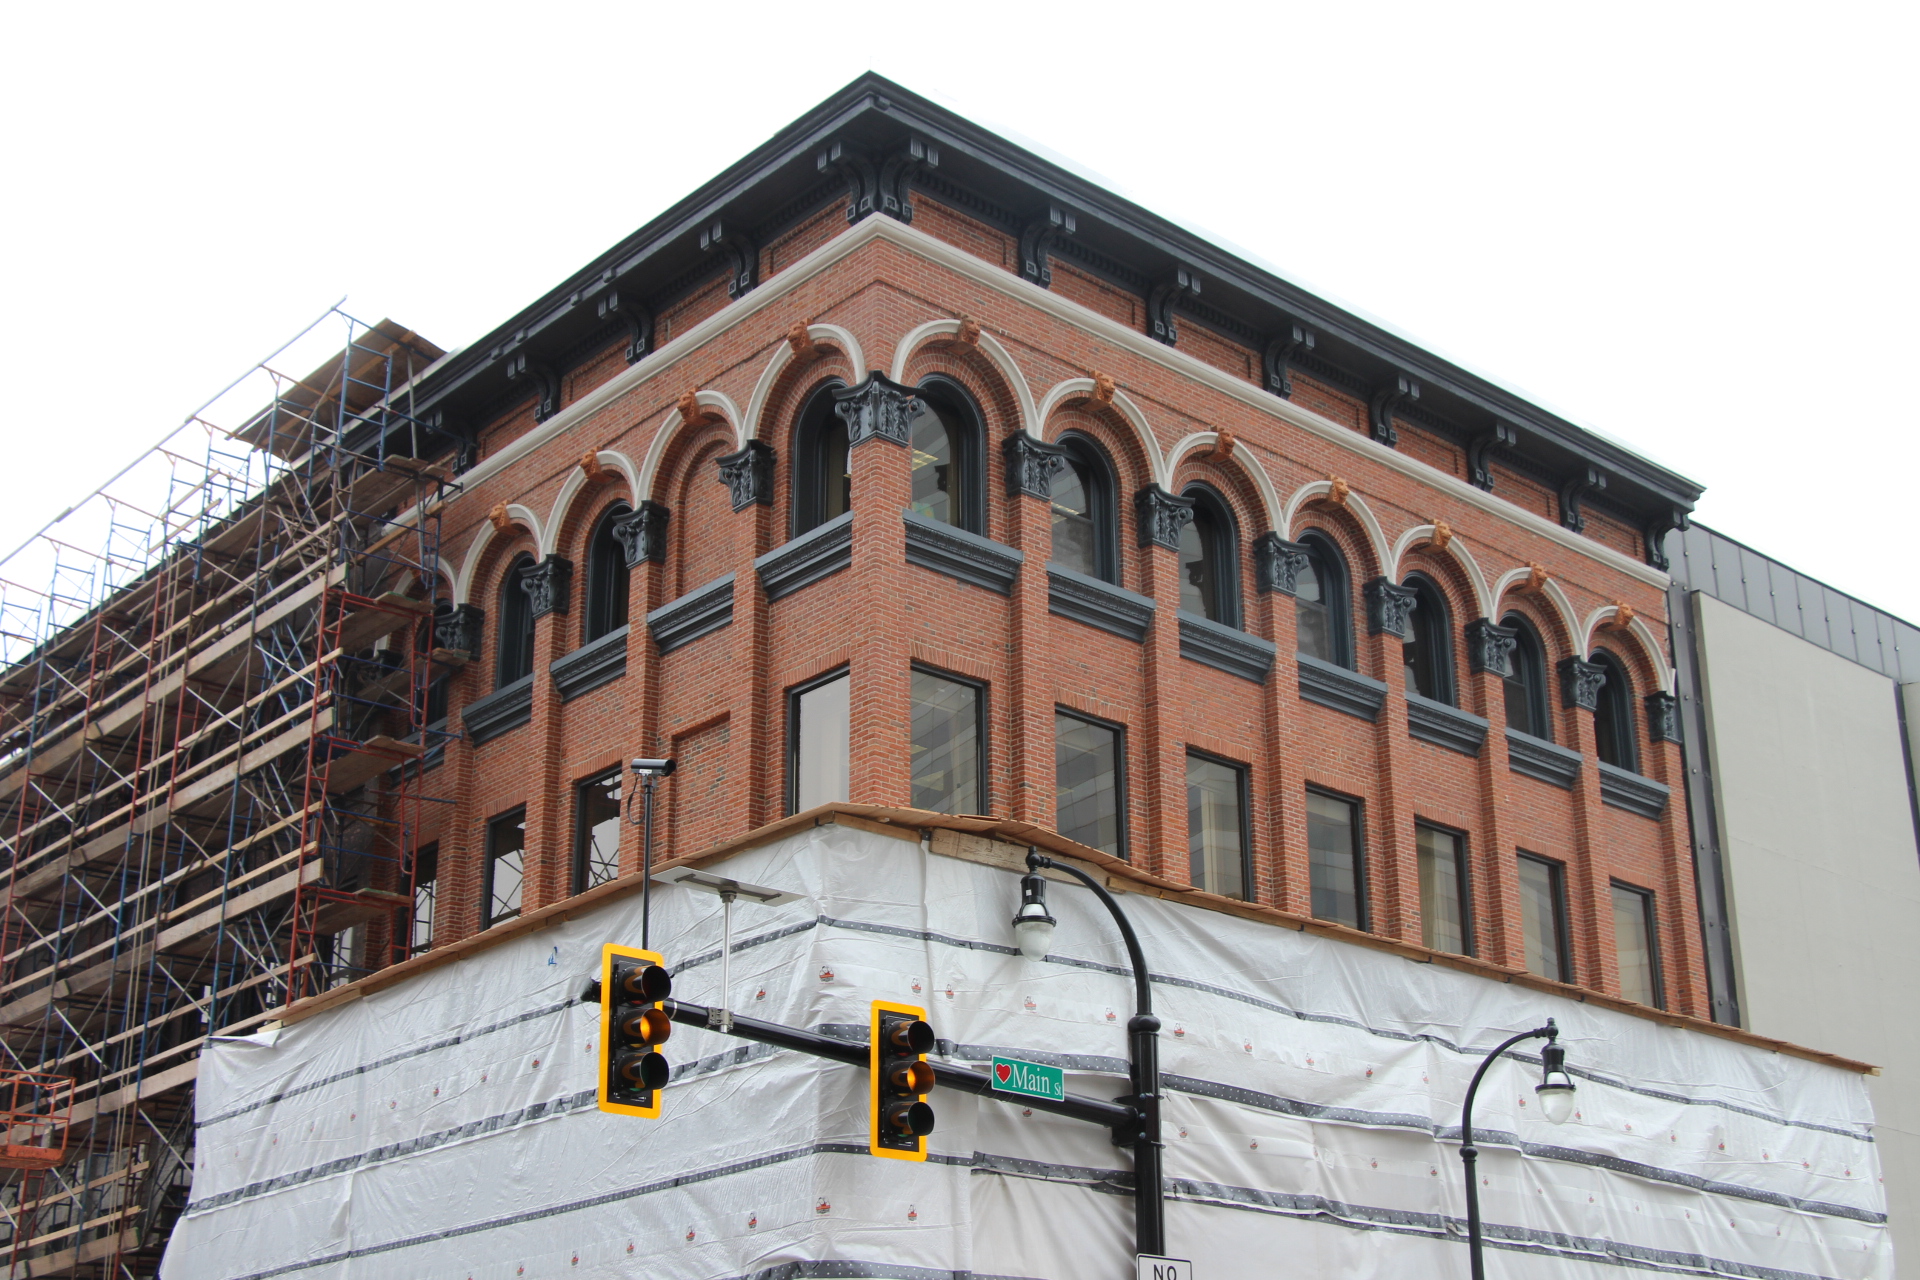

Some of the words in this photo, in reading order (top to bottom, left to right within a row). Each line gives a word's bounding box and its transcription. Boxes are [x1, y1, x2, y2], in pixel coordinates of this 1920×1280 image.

[1012, 1063, 1050, 1094] Main
[1054, 1082, 1062, 1096] St
[1153, 1264, 1177, 1280] NO
